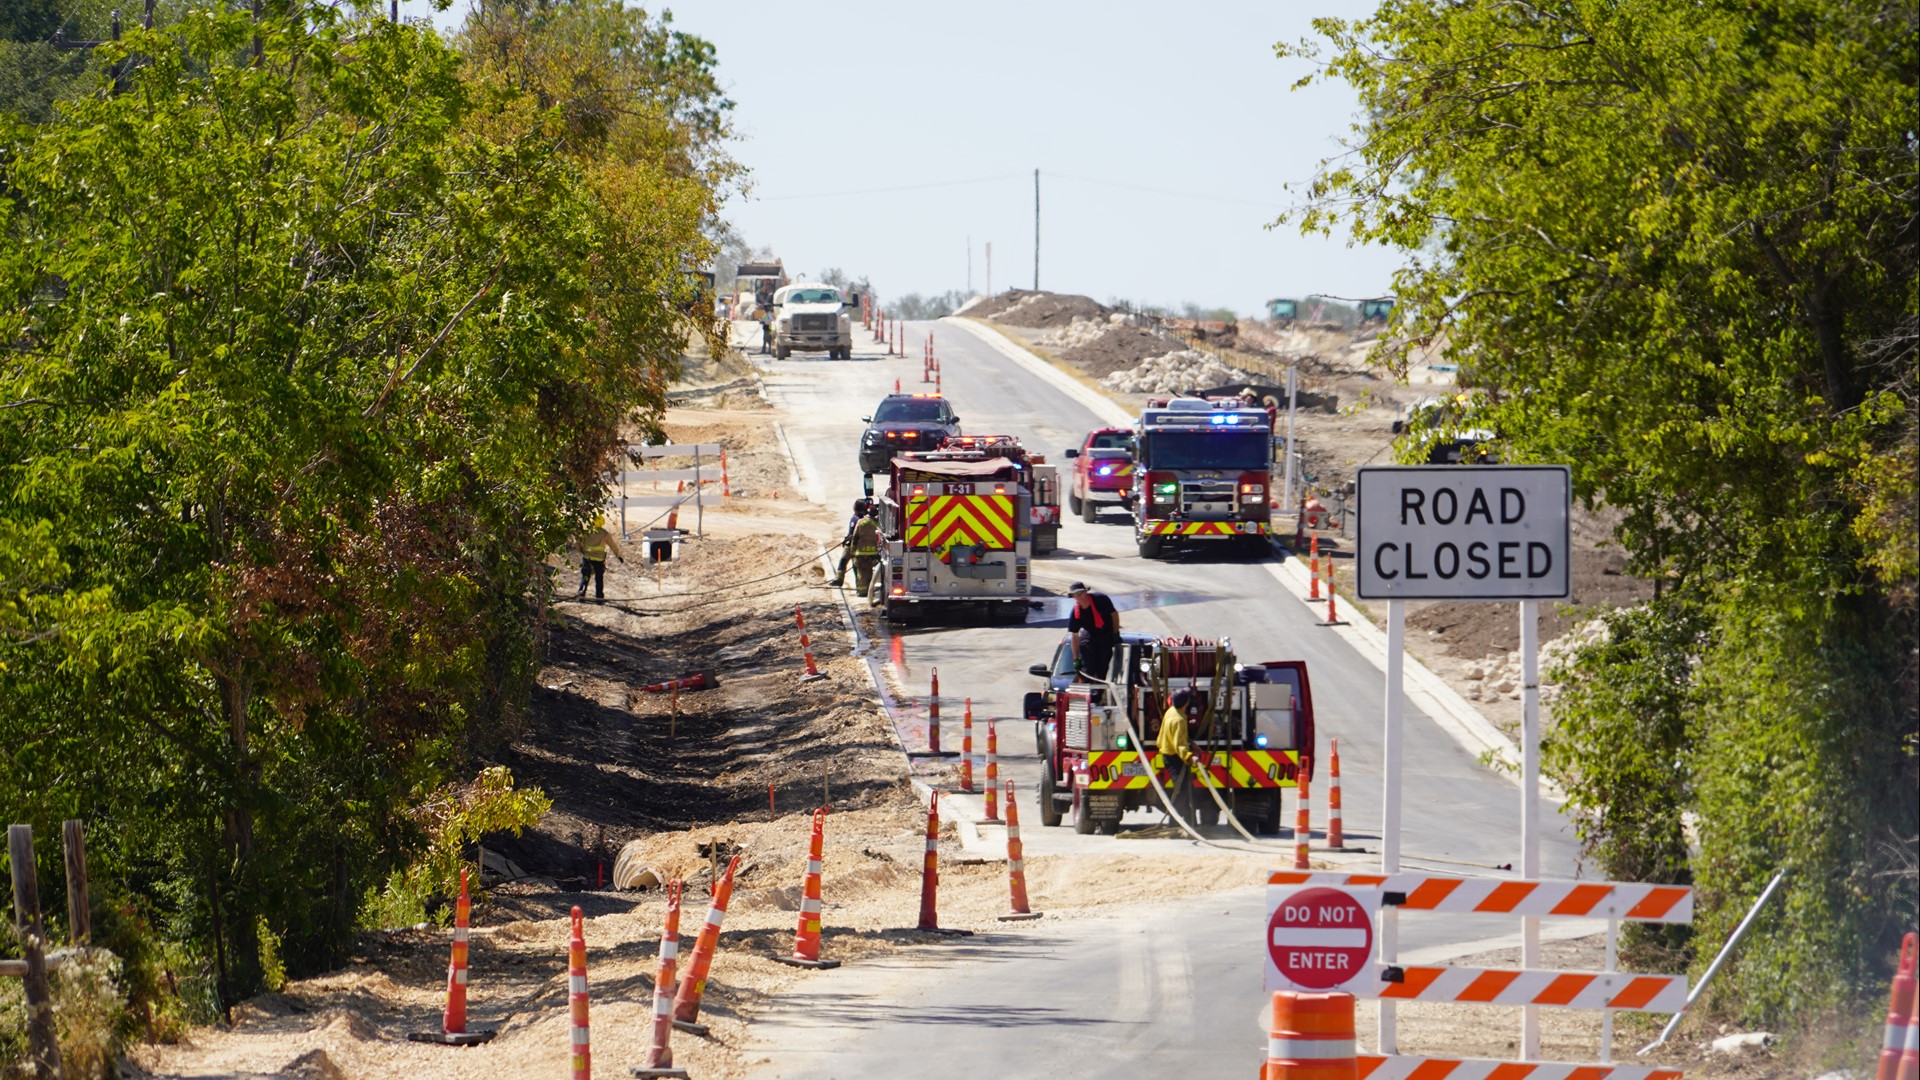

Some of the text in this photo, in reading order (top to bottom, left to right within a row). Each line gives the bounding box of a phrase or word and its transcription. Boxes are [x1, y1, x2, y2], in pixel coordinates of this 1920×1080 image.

[948, 484, 970, 495] T-31
[1401, 487, 1525, 525] ROAD
[1374, 541, 1552, 580] CLOSED
[1285, 906, 1356, 923] DO NOT
[1289, 952, 1349, 969] ENTER
